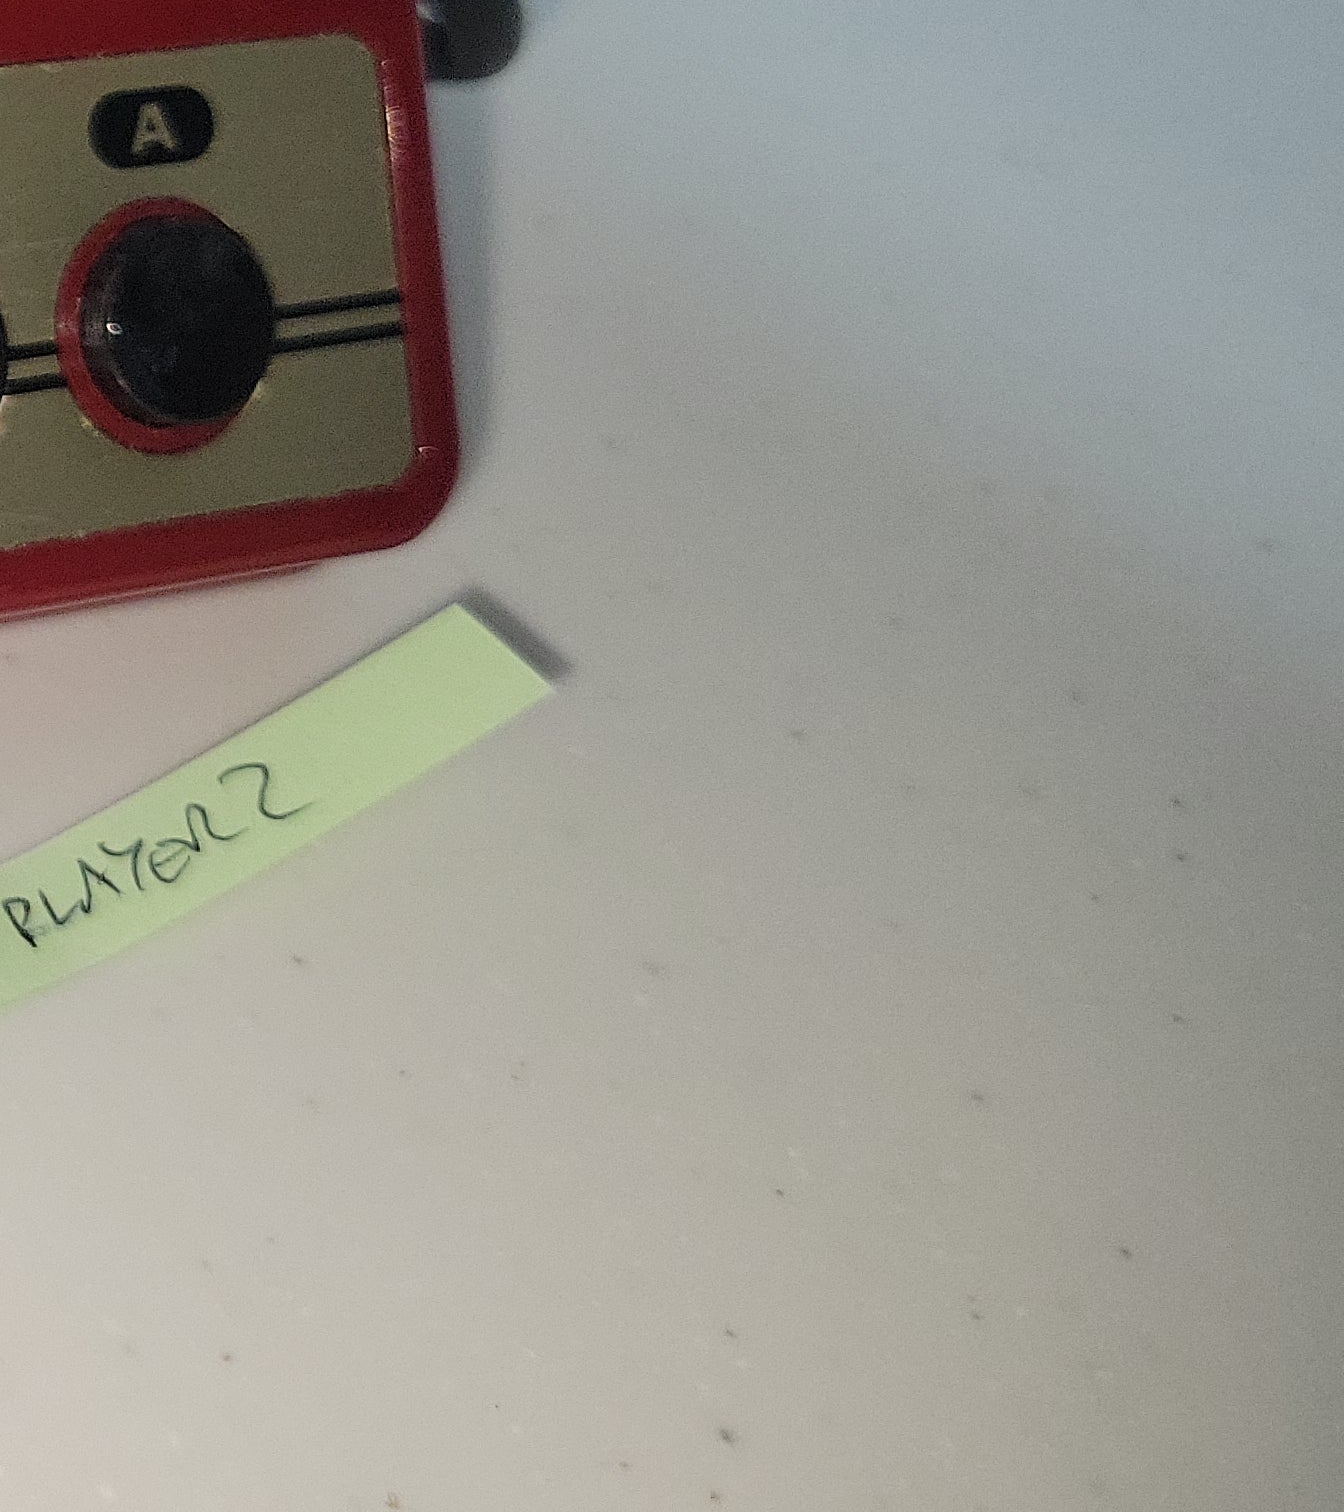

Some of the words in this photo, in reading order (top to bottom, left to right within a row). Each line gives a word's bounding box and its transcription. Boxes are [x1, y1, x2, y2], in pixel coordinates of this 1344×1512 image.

[131, 102, 181, 156] A
[2, 801, 248, 948] PLAYER
[218, 761, 313, 821] 2
